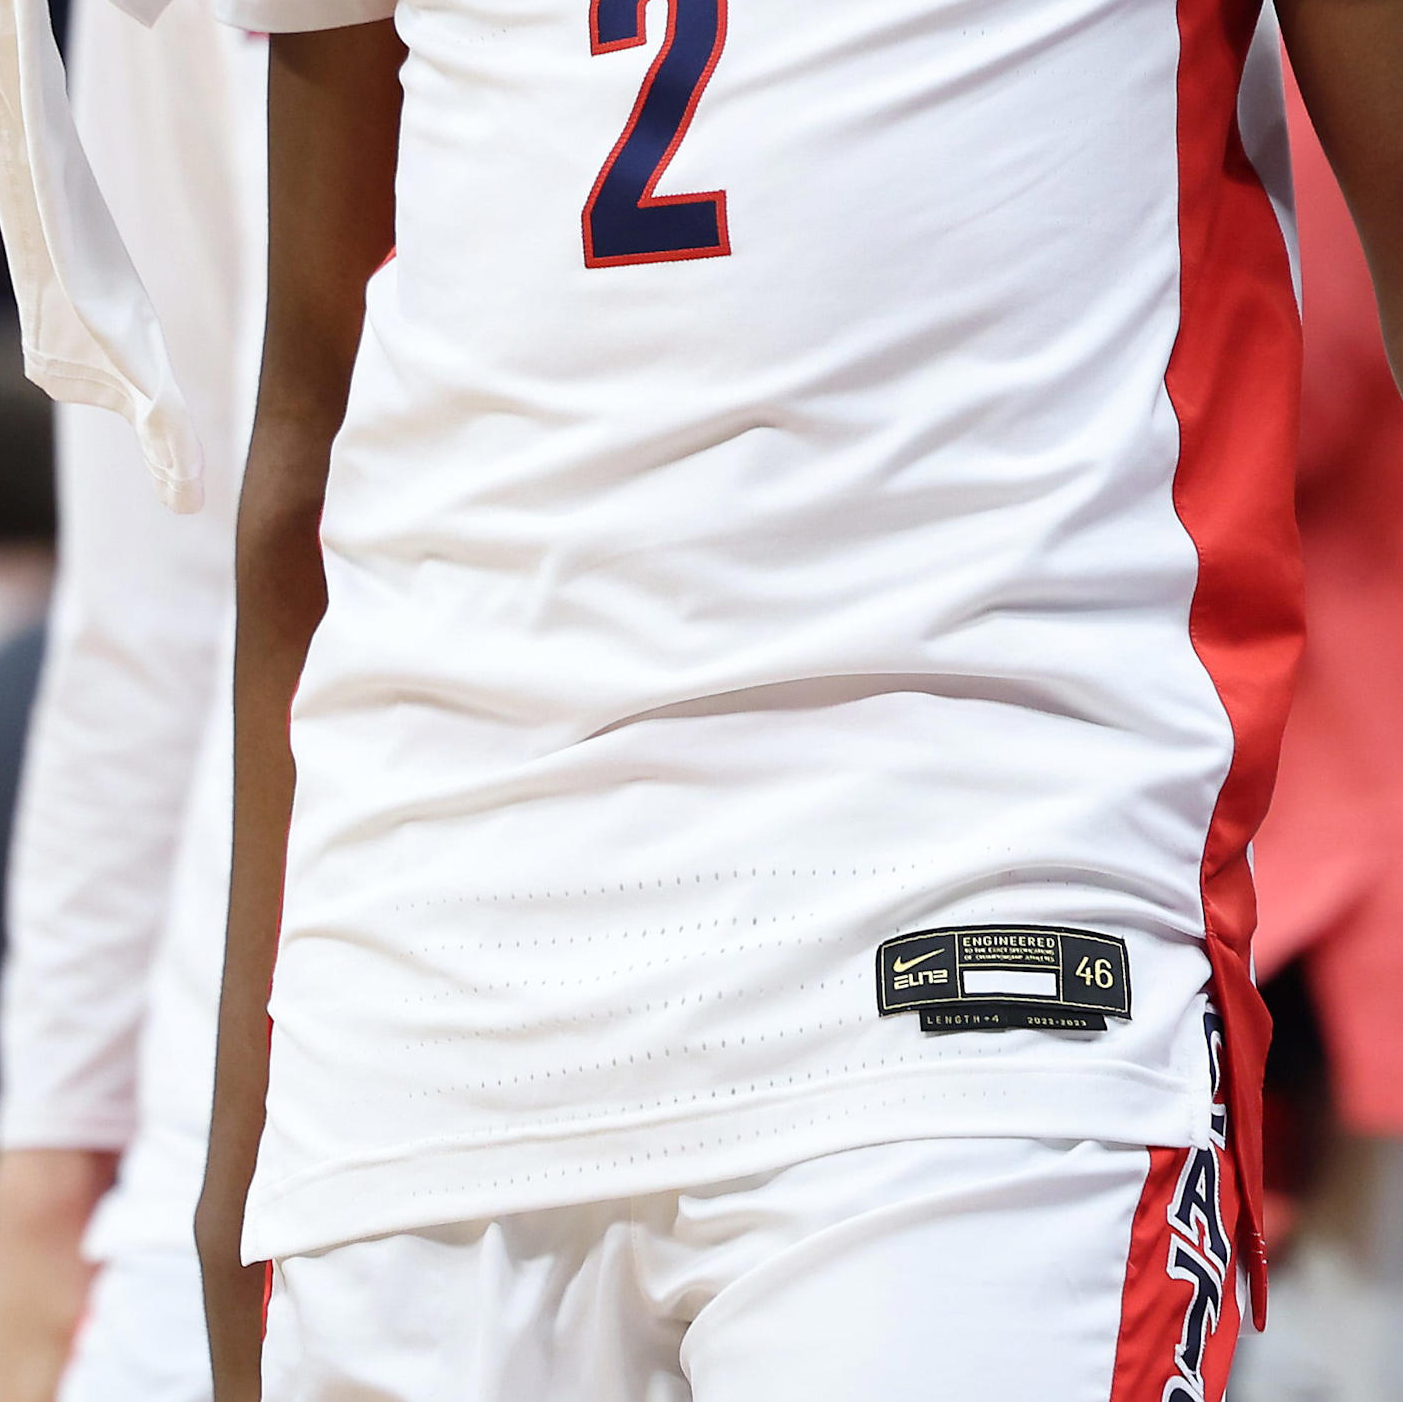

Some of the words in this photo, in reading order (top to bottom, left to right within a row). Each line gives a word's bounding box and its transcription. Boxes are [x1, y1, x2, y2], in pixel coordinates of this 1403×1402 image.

[962, 935, 1056, 948] ENGINEERED
[893, 968, 948, 990] ELITE
[1075, 956, 1114, 989] 46
[926, 1015, 981, 1025] LENGTH
